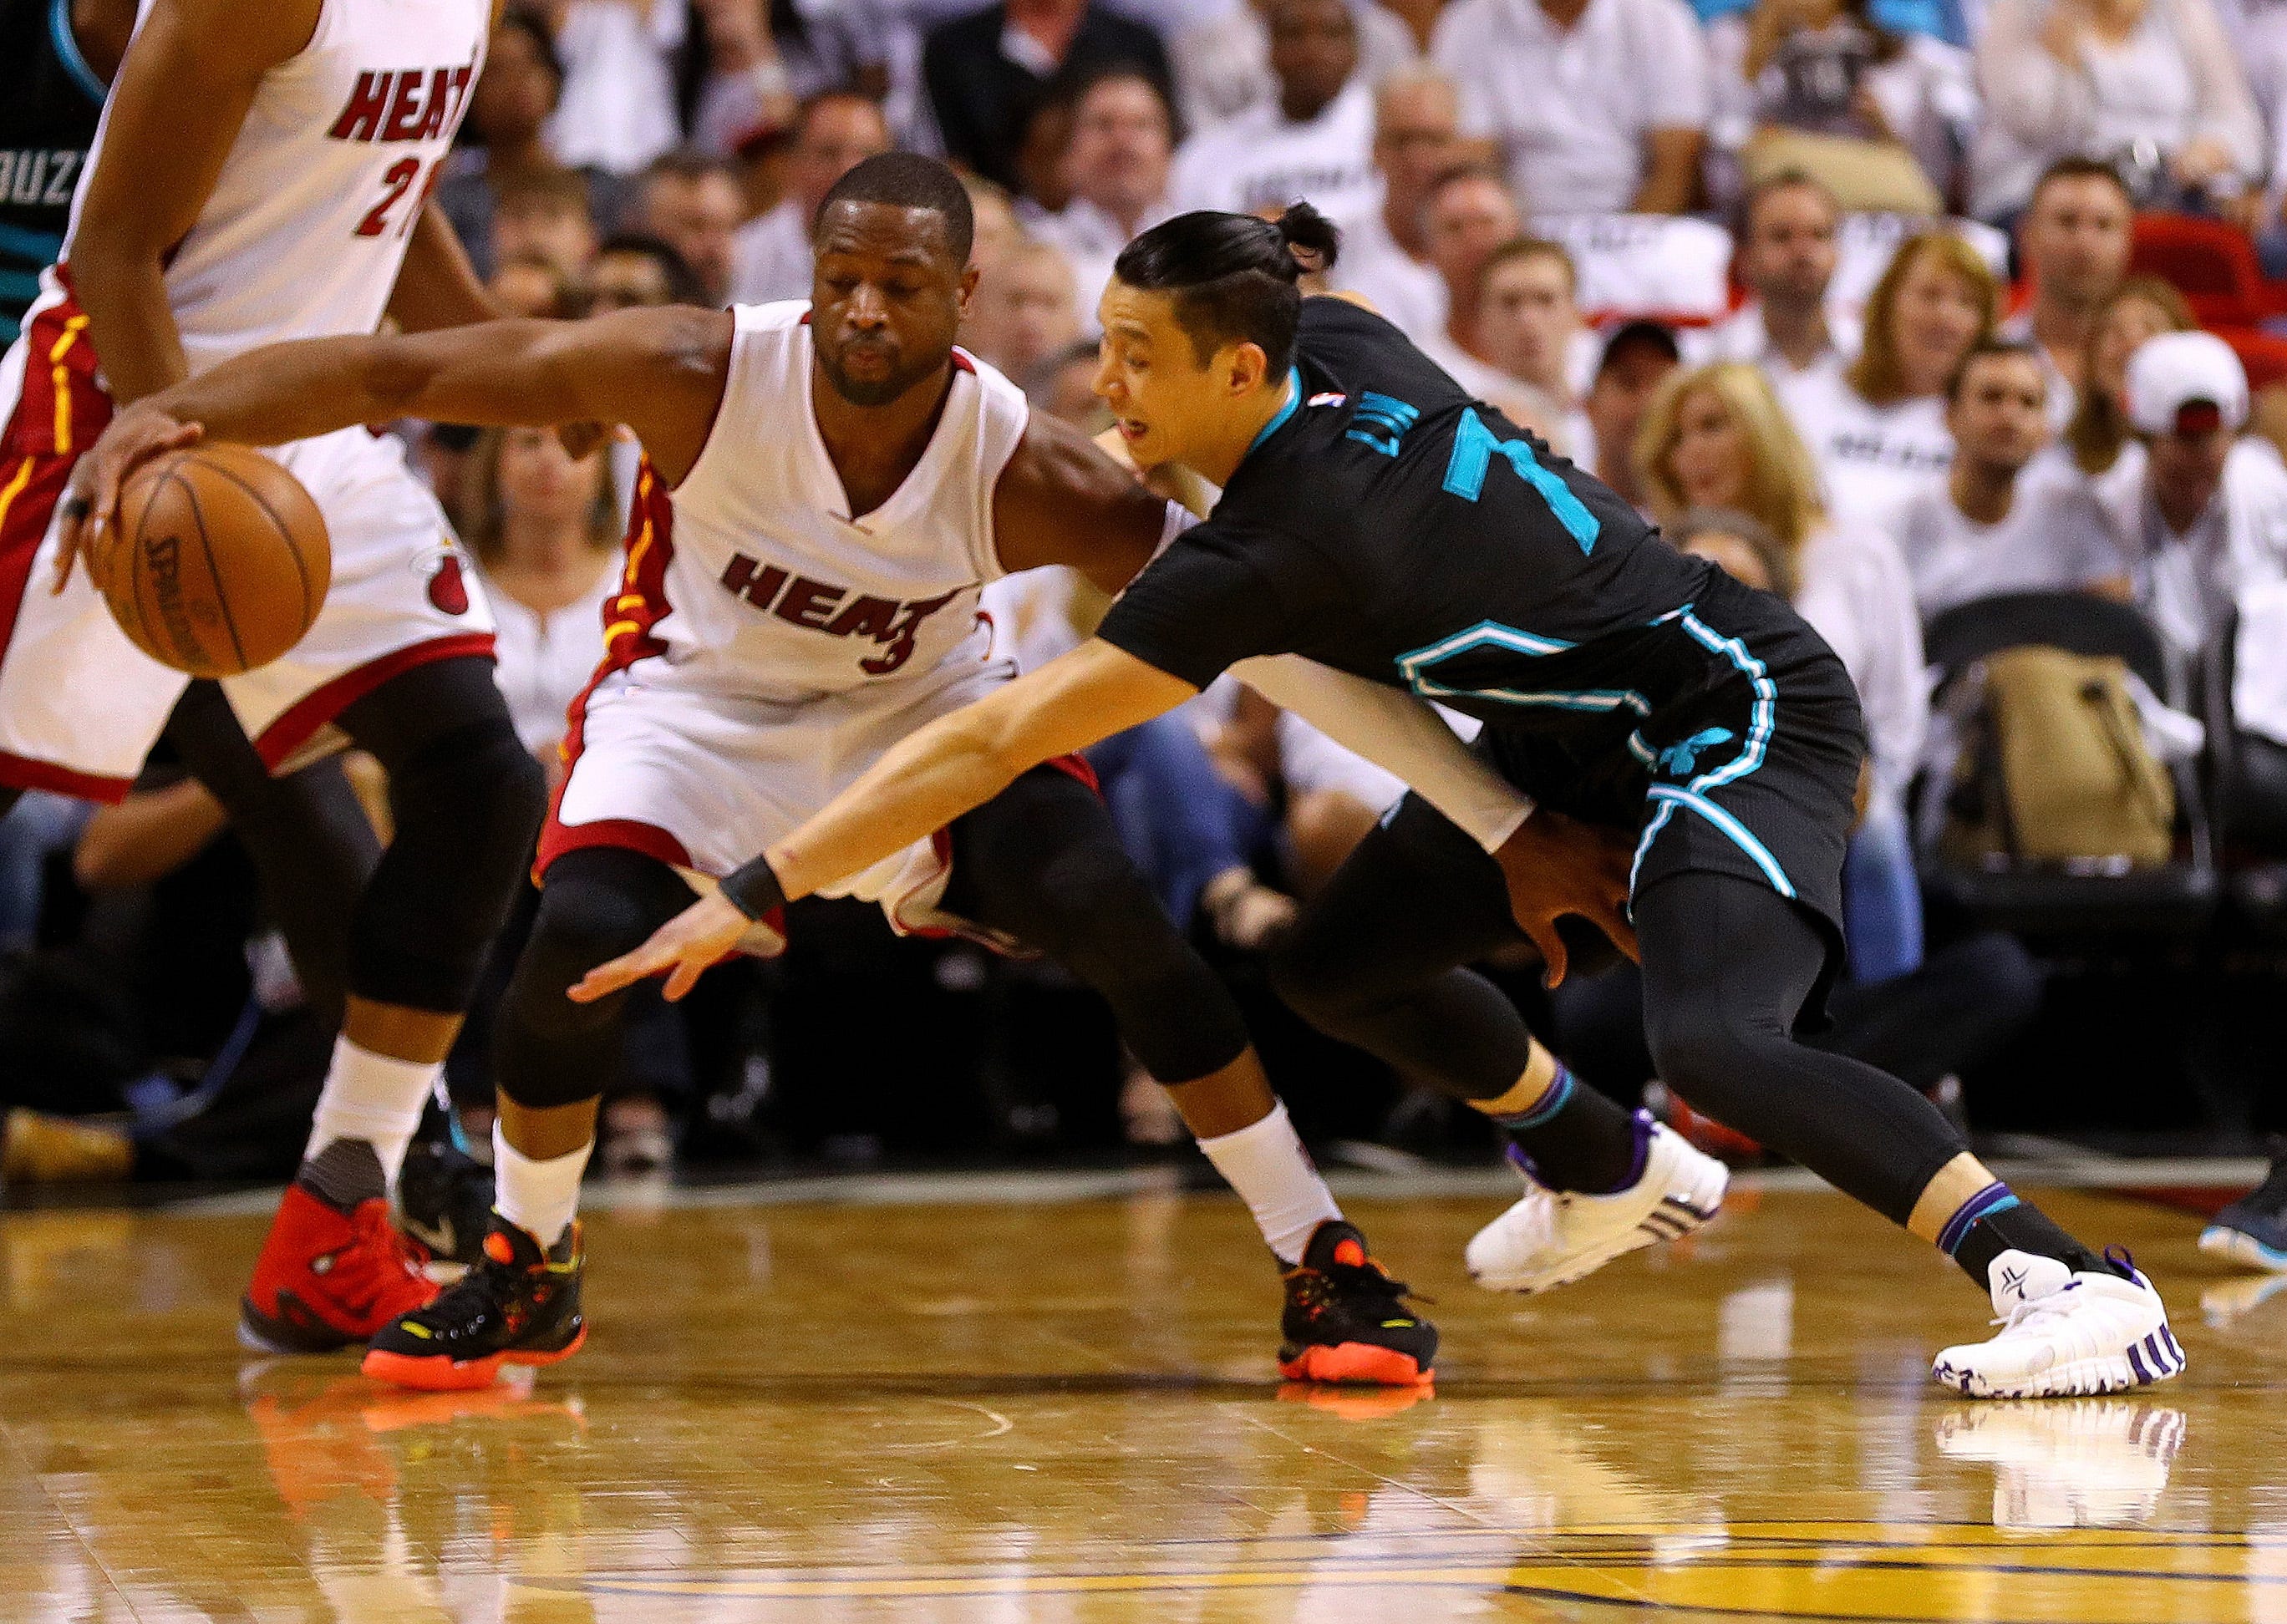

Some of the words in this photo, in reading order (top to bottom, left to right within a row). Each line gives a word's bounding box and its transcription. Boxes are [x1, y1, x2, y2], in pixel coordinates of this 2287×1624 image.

[0, 150, 86, 203] UZ
[1442, 405, 1602, 557] 7
[722, 551, 968, 643] HEAT
